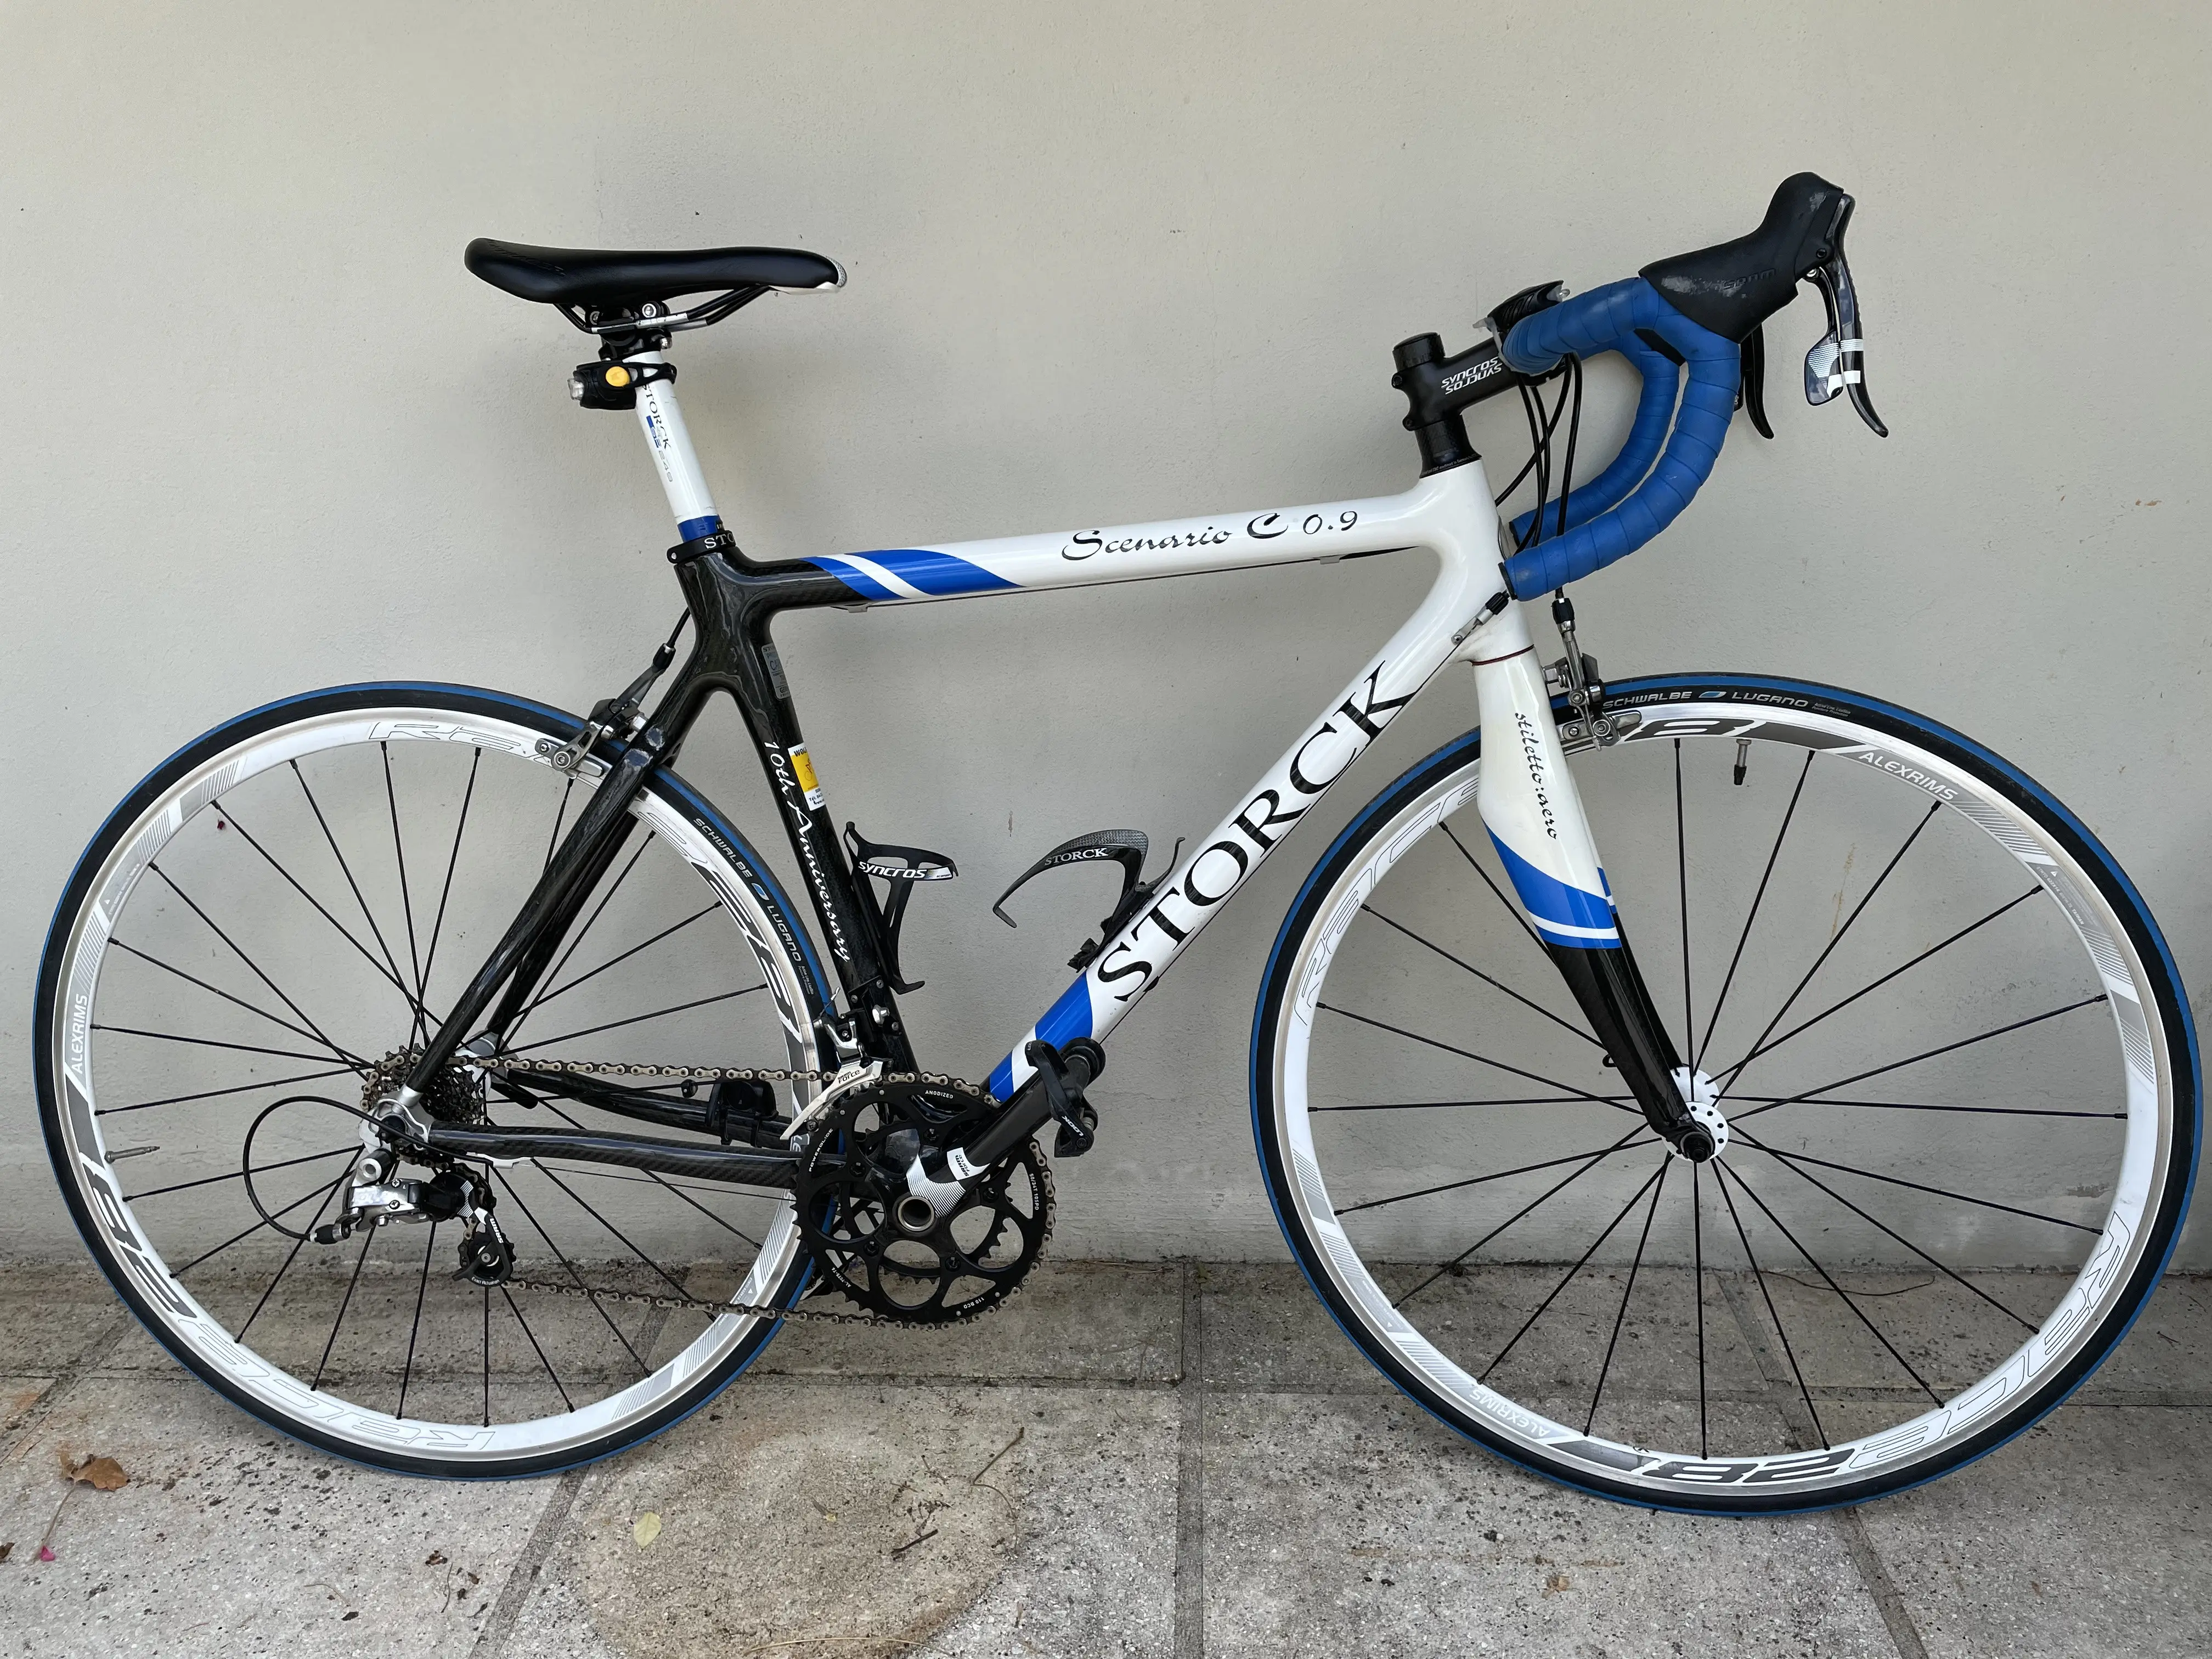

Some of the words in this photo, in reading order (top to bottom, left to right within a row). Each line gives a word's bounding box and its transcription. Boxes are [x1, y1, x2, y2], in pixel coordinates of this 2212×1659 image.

[1723, 268, 1776, 290] SRAM
[1062, 525, 1231, 561] Scenario
[1302, 510, 1358, 536] 0.9
[1602, 691, 1692, 709] SCHWALBE
[1731, 692, 1809, 707] LUGANO
[1859, 752, 1958, 800] ALEXRIMS
[1098, 659, 1423, 1002] STORCK
[764, 741, 795, 795] 10th
[787, 801, 850, 963] Anniversary
[1045, 848, 1108, 866] STORCK
[693, 818, 753, 878] SCHWALBE
[767, 905, 802, 962] LUGANO
[71, 994, 88, 1075] ALEXRIMS
[925, 1090, 953, 1099] ANODIZED
[1061, 1115, 1084, 1137] LOOK
[808, 1128, 833, 1172] POWERGLIDE
[955, 1154, 969, 1176] SRAM
[1029, 1173, 1038, 1192] 50/34T
[489, 1218, 504, 1244] SRAM
[1469, 1389, 1550, 1437] ALEXRIMS
